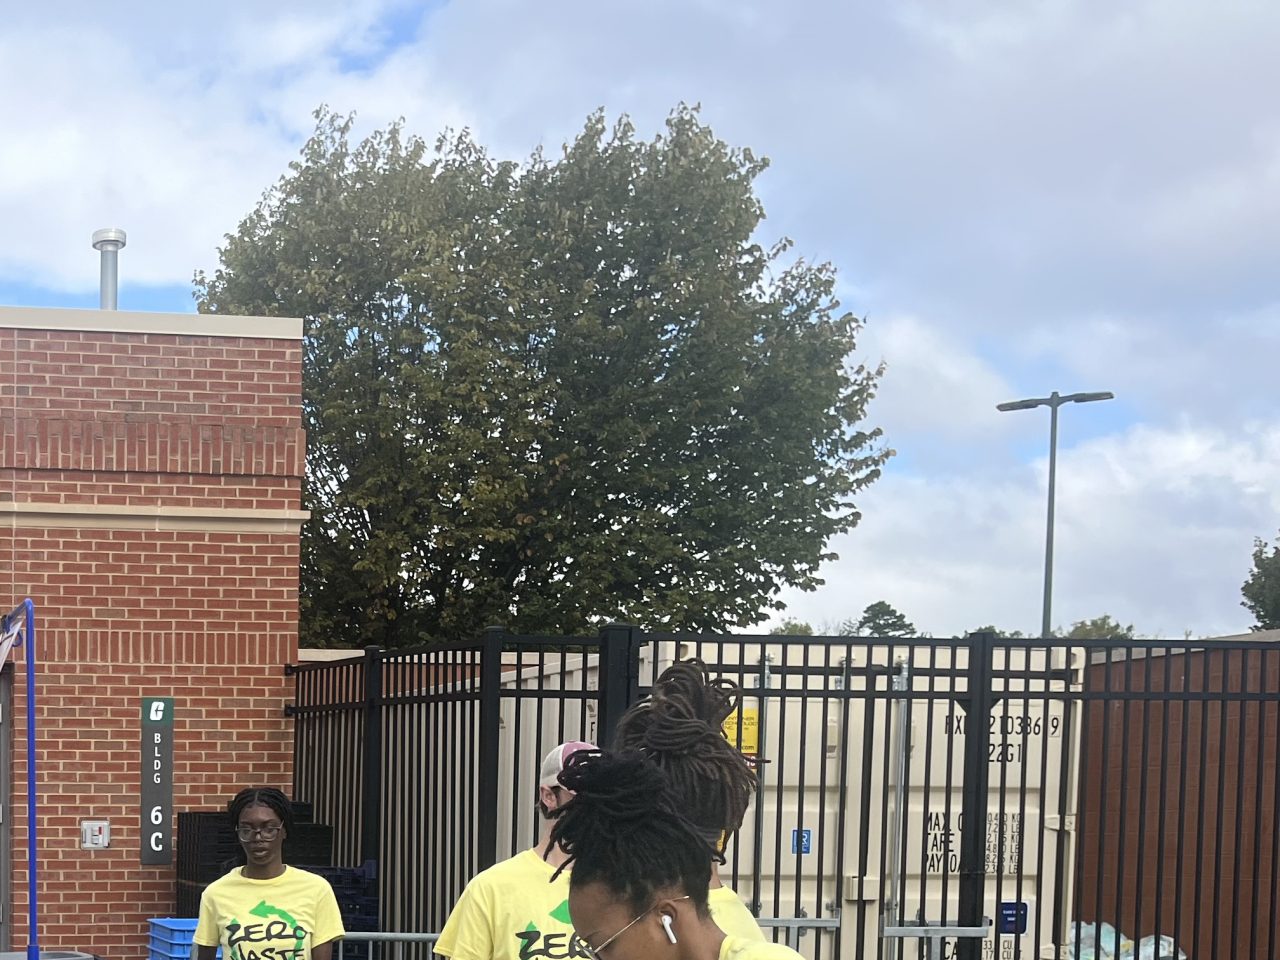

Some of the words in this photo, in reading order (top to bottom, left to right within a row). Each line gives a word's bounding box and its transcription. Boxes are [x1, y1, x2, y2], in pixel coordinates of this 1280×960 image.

[1051, 717, 1059, 736] 9
[153, 733, 161, 784] BLDG
[226, 921, 308, 947] ZERO
